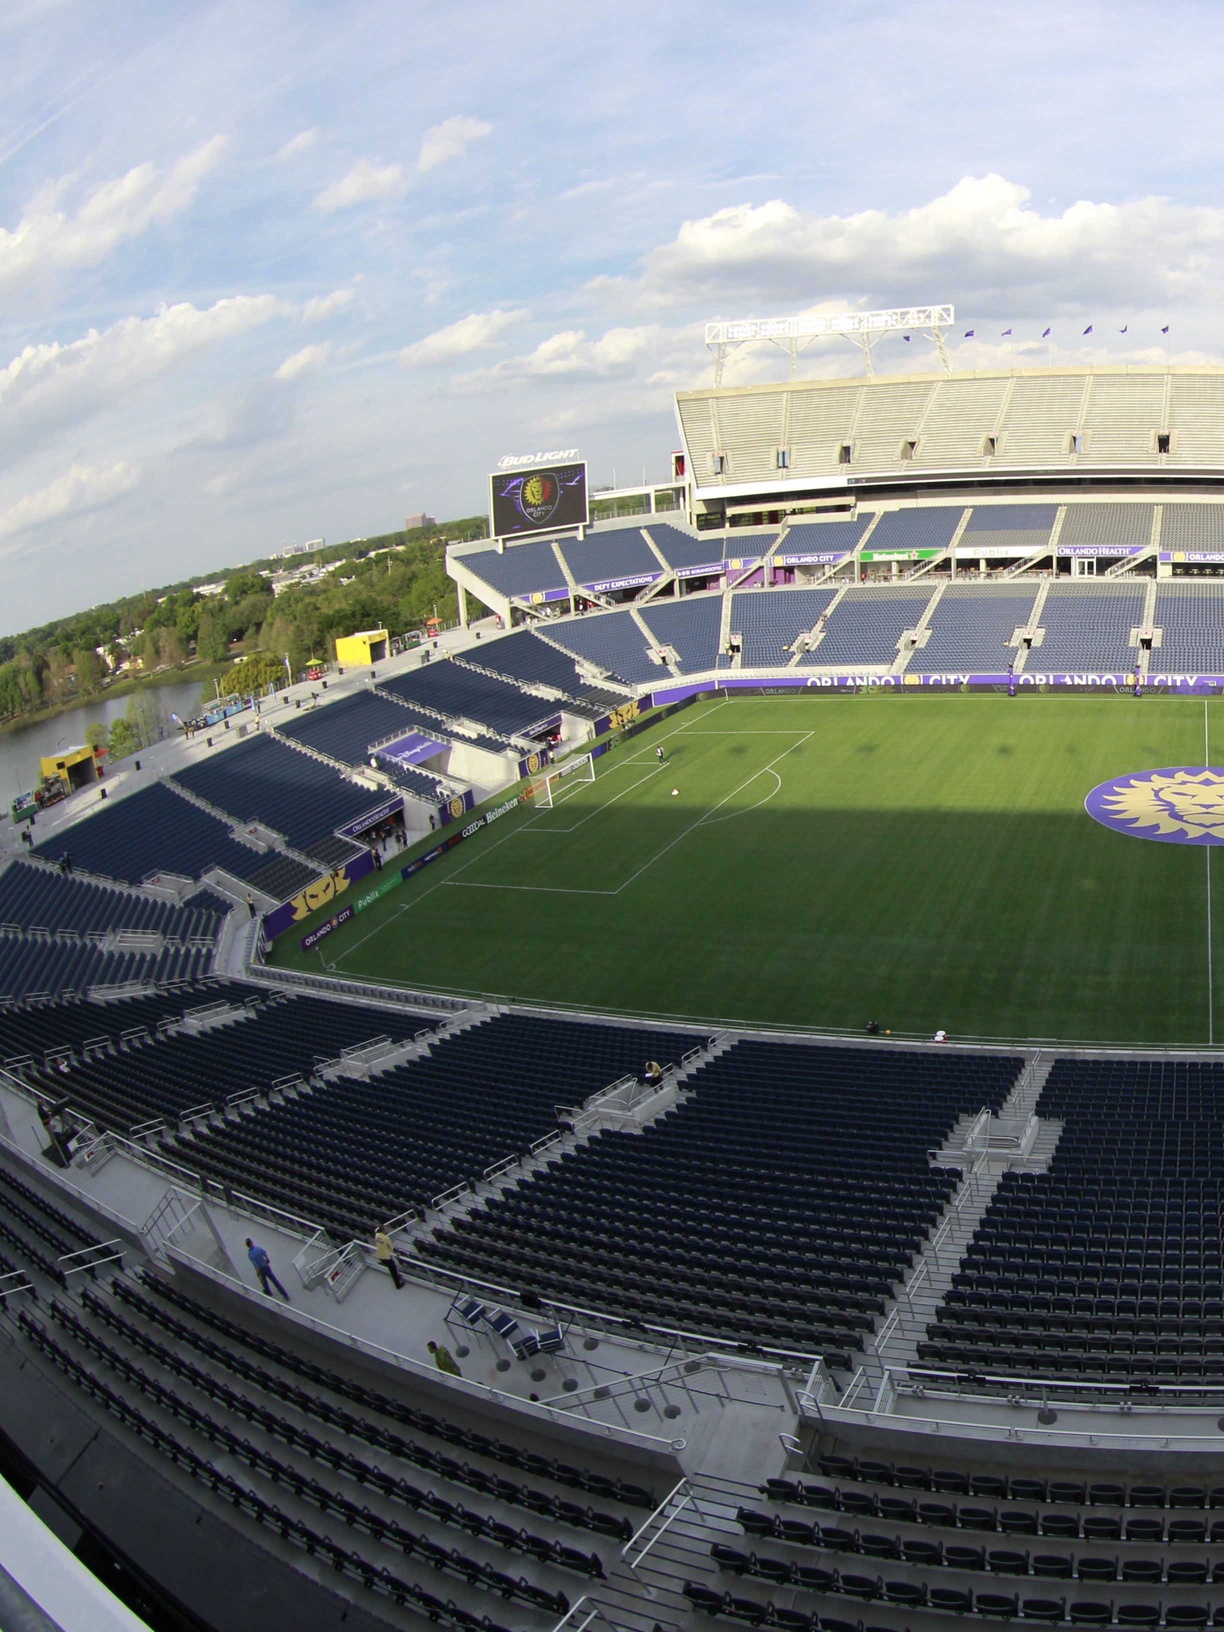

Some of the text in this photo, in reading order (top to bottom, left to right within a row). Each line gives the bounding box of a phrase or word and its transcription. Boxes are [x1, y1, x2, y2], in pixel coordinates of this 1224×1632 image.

[526, 504, 553, 514] ORLANDO
[872, 551, 908, 561] Heineken
[1058, 547, 1131, 555] ORLANDO HEALTH
[786, 554, 834, 564] ORLANDO CITY
[594, 575, 653, 591] DEFY EXPECTATIONS
[806, 674, 971, 687] ORLANDO CITY
[1019, 674, 1199, 687] ORLANDO CITY
[1119, 687, 1156, 695] ORLNDO
[486, 797, 519, 824] Heineken
[304, 909, 351, 947] ORLANDO CITY
